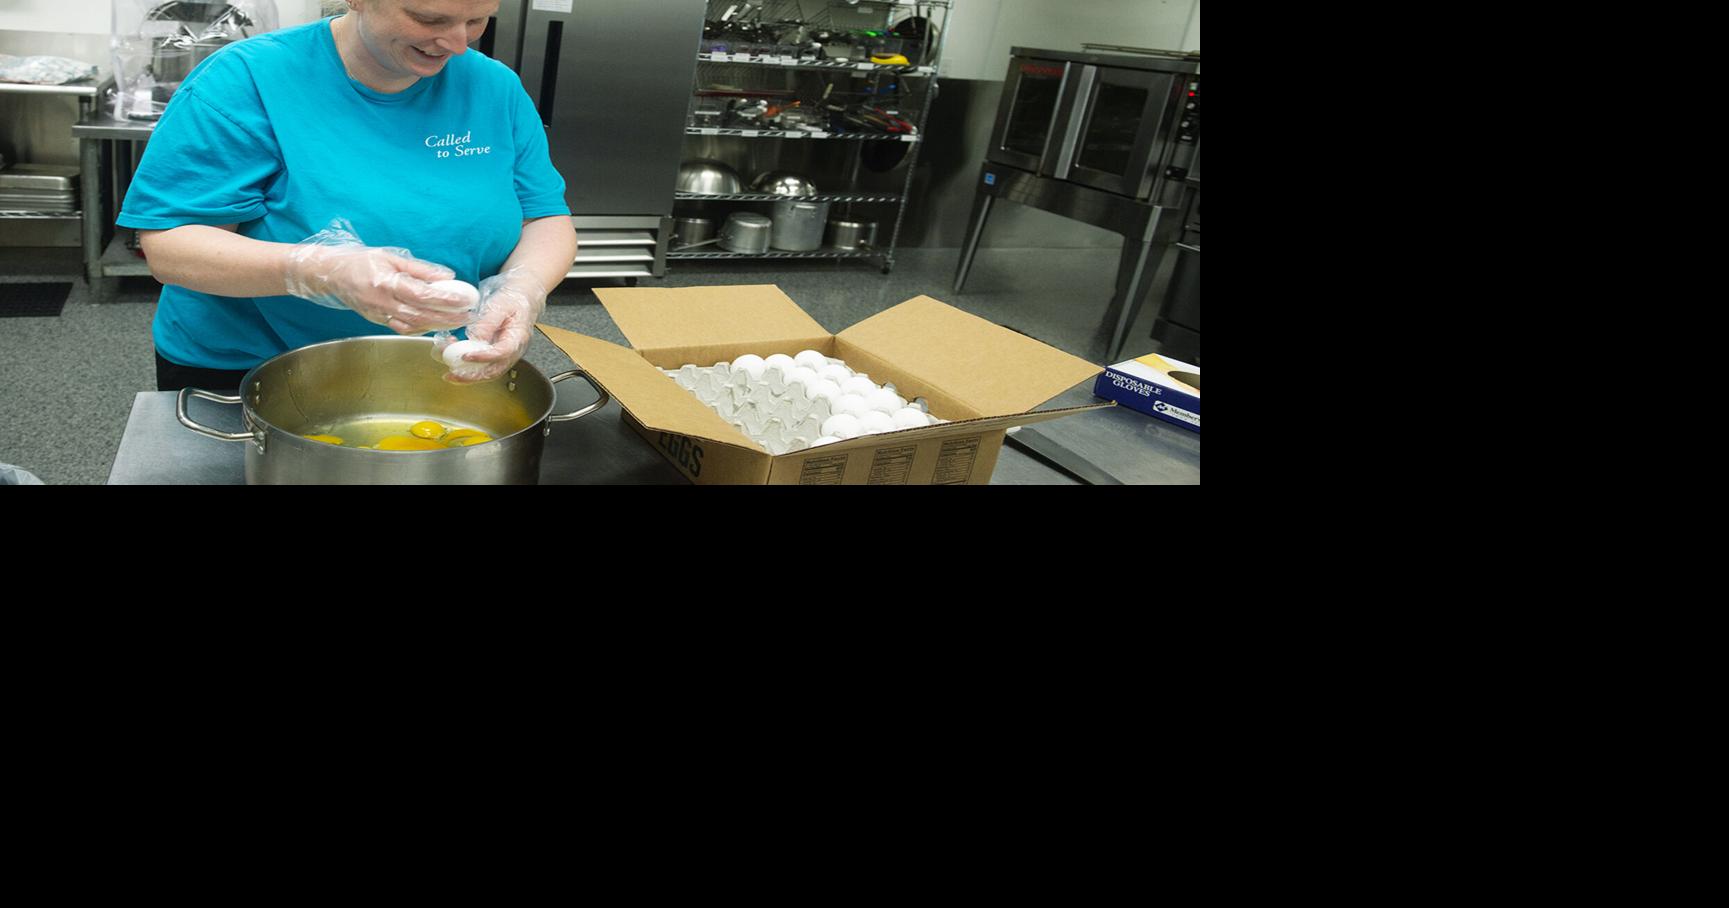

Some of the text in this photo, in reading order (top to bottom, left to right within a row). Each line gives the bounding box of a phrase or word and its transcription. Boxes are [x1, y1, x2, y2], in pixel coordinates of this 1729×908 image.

[425, 130, 471, 148] Called
[437, 144, 491, 158] to Serve
[1105, 371, 1162, 395] DISPOSABLE
[1112, 380, 1151, 397] GLOVES
[659, 432, 705, 477] EGGS
